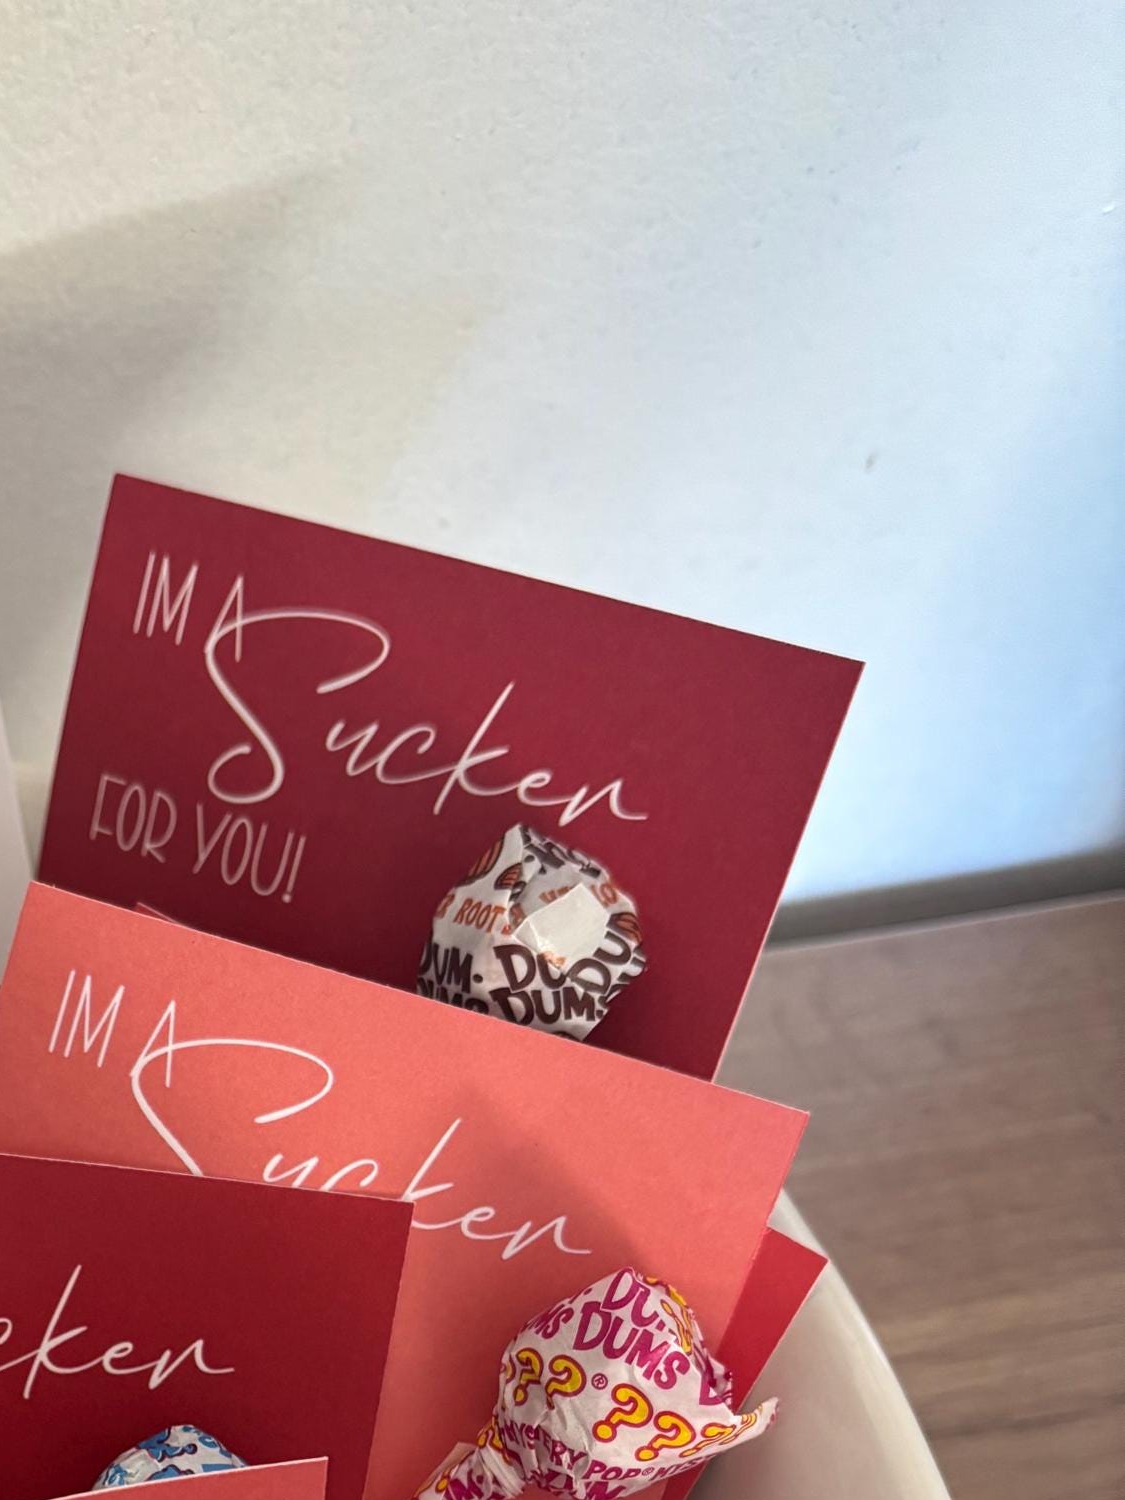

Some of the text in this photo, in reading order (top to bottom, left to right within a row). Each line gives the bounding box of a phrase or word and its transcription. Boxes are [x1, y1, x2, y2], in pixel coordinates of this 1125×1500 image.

[132, 551, 245, 662] IM A
[204, 608, 649, 827] Sucker
[89, 772, 307, 905] FOR YOU!
[453, 898, 507, 934] ROOT
[48, 967, 176, 1089] IM A
[573, 1300, 691, 1390] DUMS
